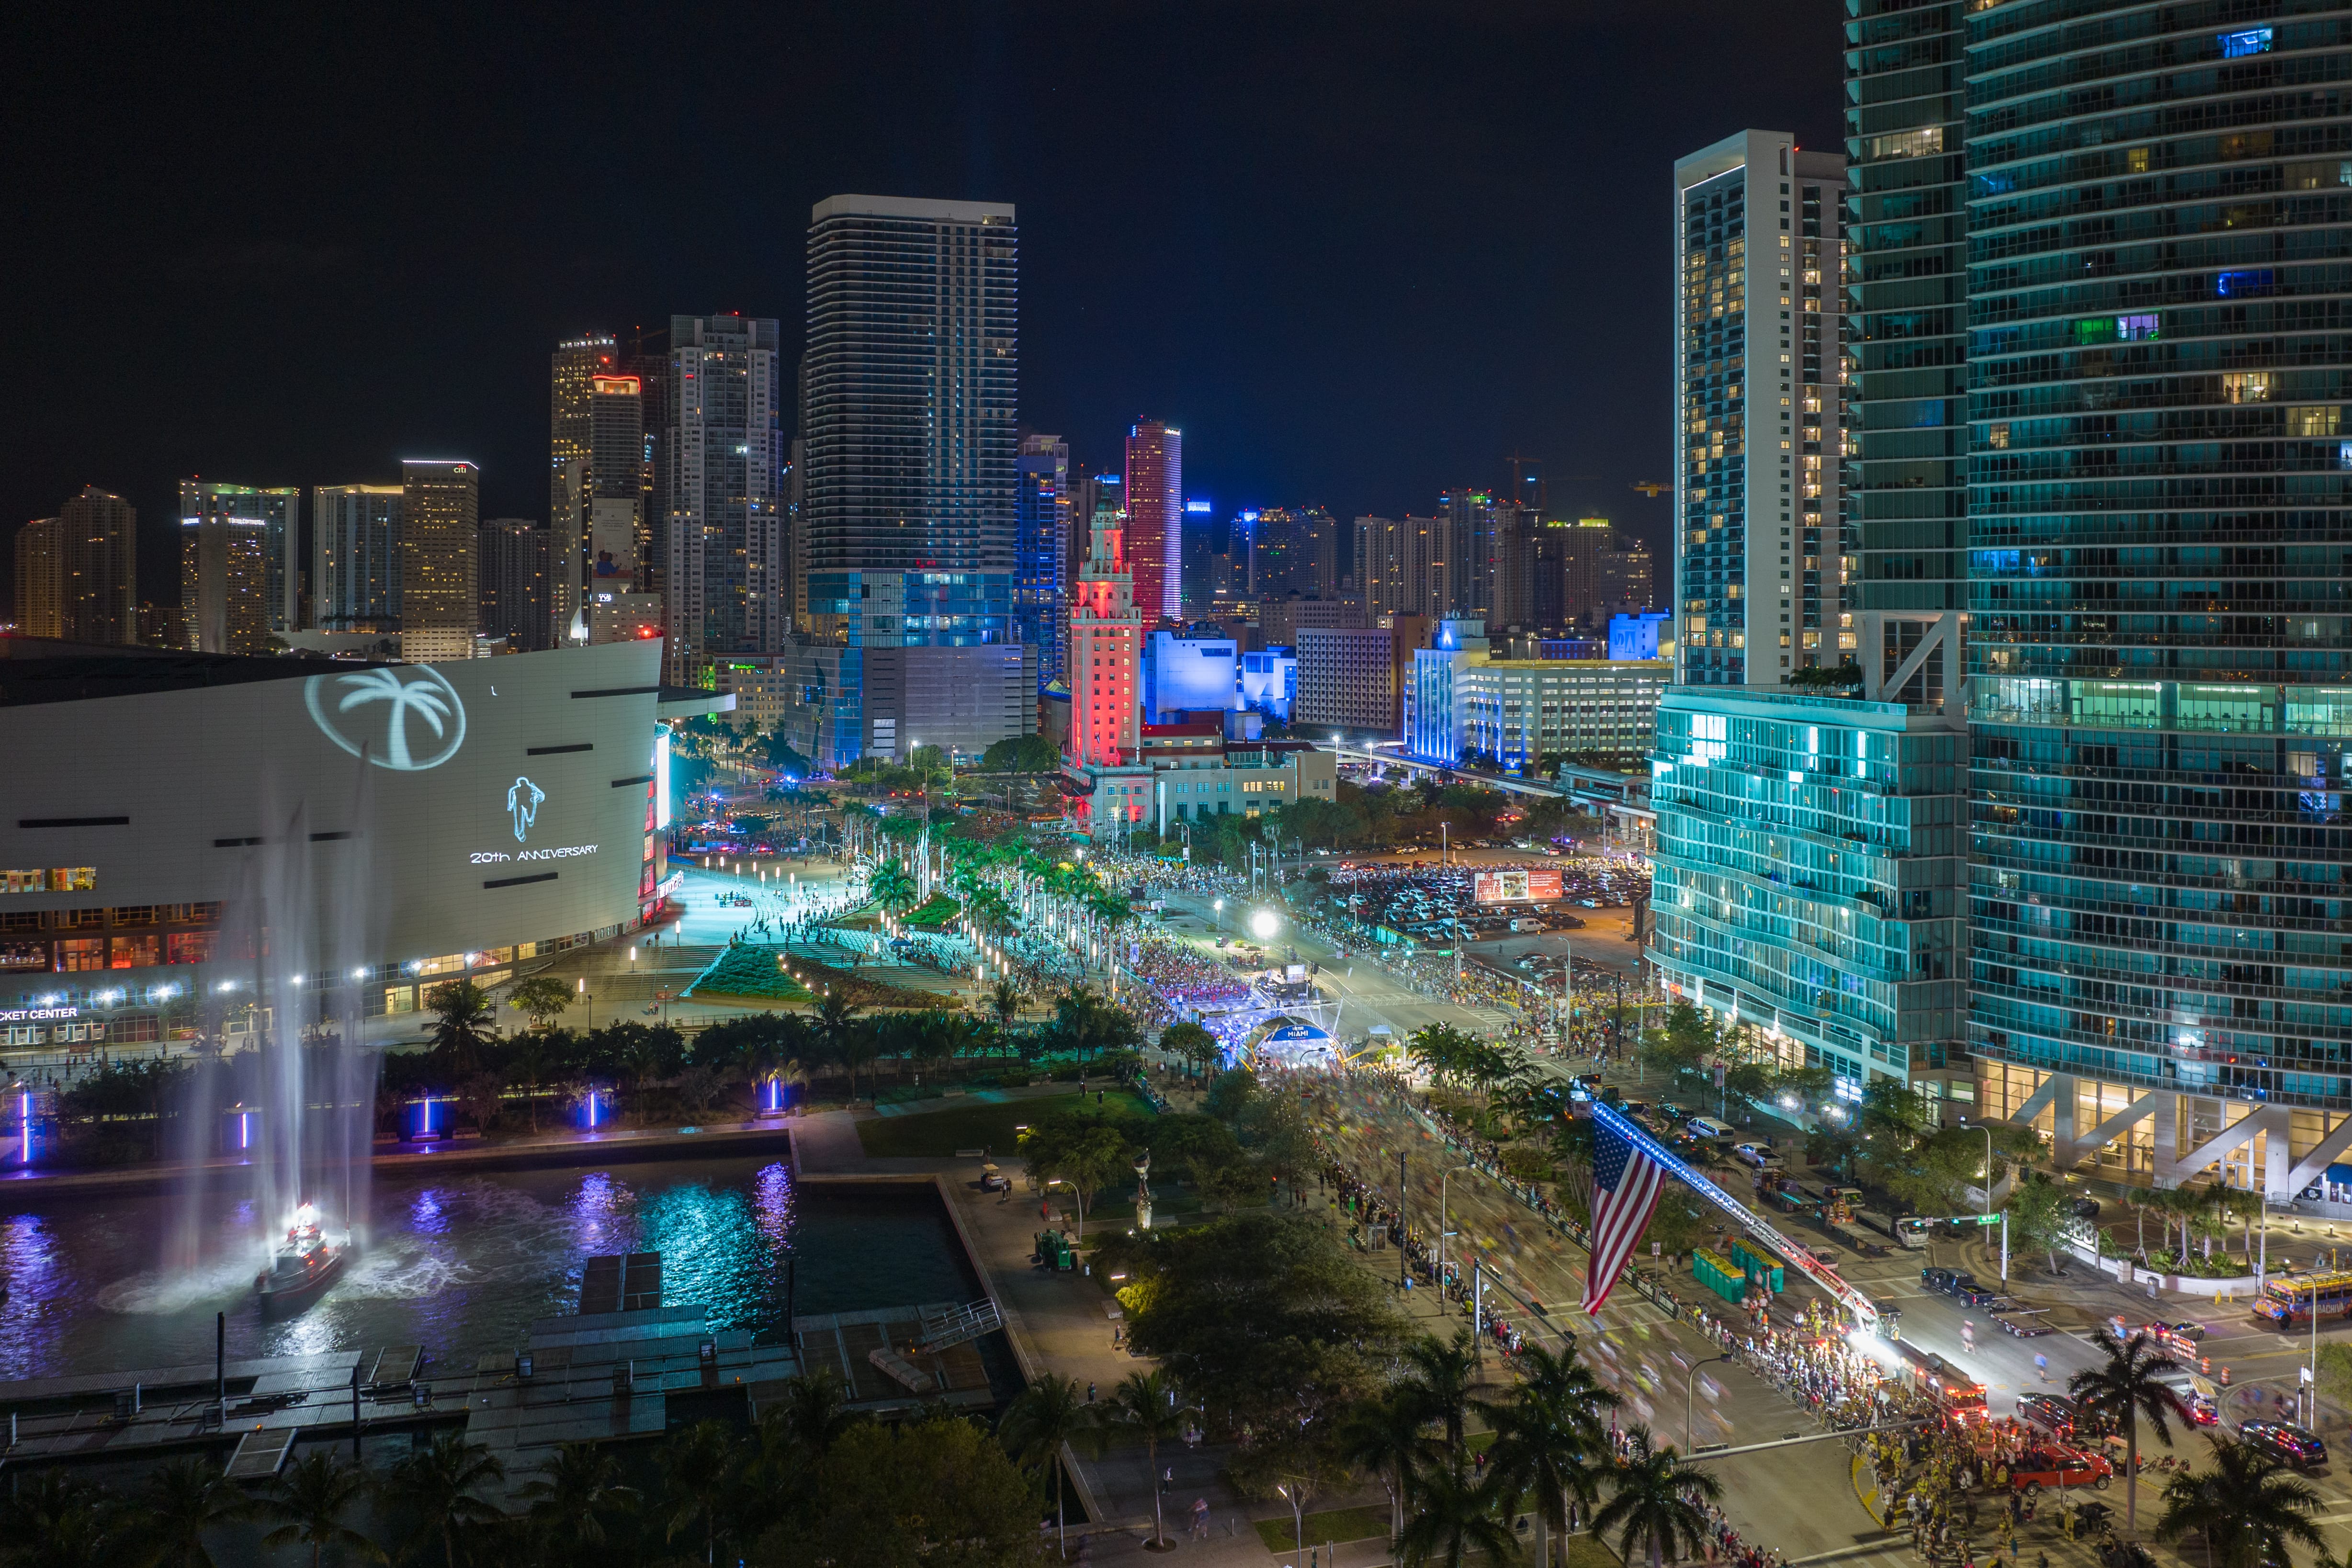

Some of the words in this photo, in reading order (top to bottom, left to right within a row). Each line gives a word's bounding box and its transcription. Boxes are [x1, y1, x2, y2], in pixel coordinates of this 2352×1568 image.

[470, 852, 496, 864] 20th
[517, 844, 598, 861] ANNIVERSARY
[0, 1010, 28, 1021] CKET
[29, 1007, 78, 1020] CENTER
[1829, 1278, 1842, 1288] MIAMI
[2306, 1301, 2345, 1316] RUBACHIVA
